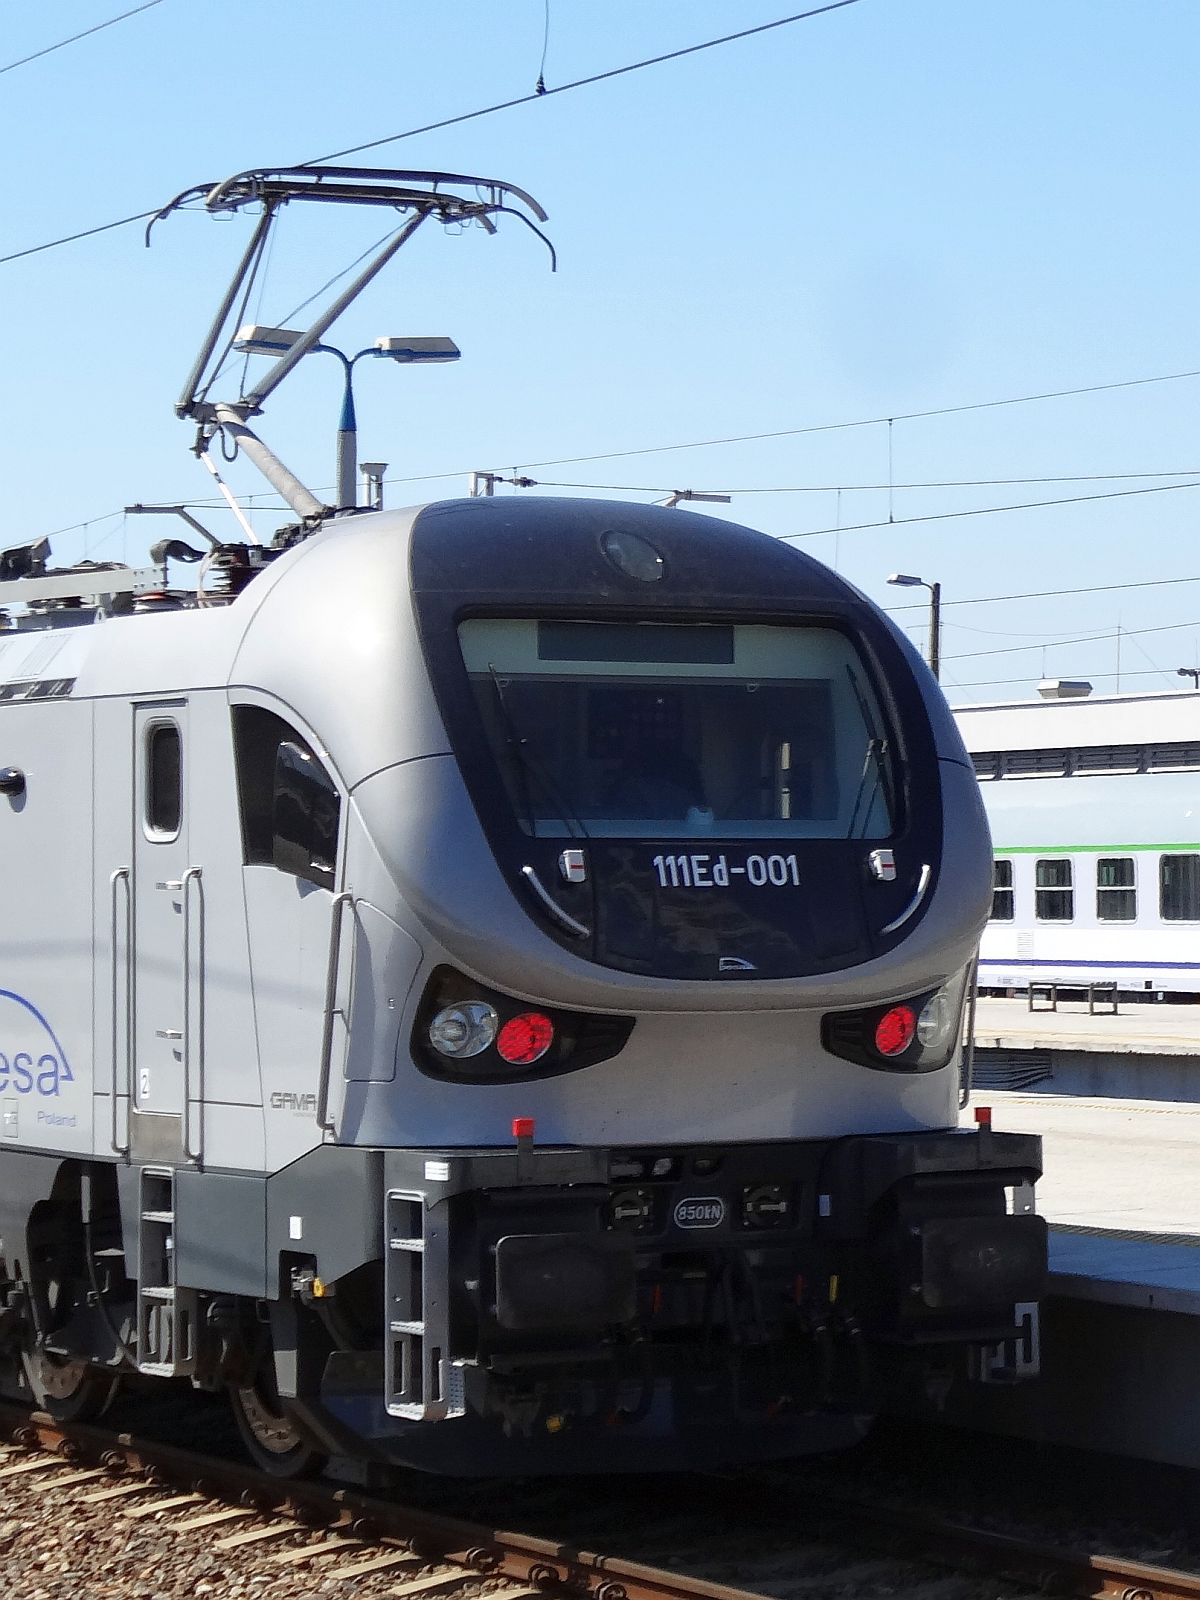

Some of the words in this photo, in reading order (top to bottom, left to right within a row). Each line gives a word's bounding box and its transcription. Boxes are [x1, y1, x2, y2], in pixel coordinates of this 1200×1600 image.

[653, 854, 800, 887] 111Ed-001
[271, 1092, 317, 1112] GAMA
[37, 1110, 77, 1128] Poland
[678, 1205, 721, 1220] 850kN
